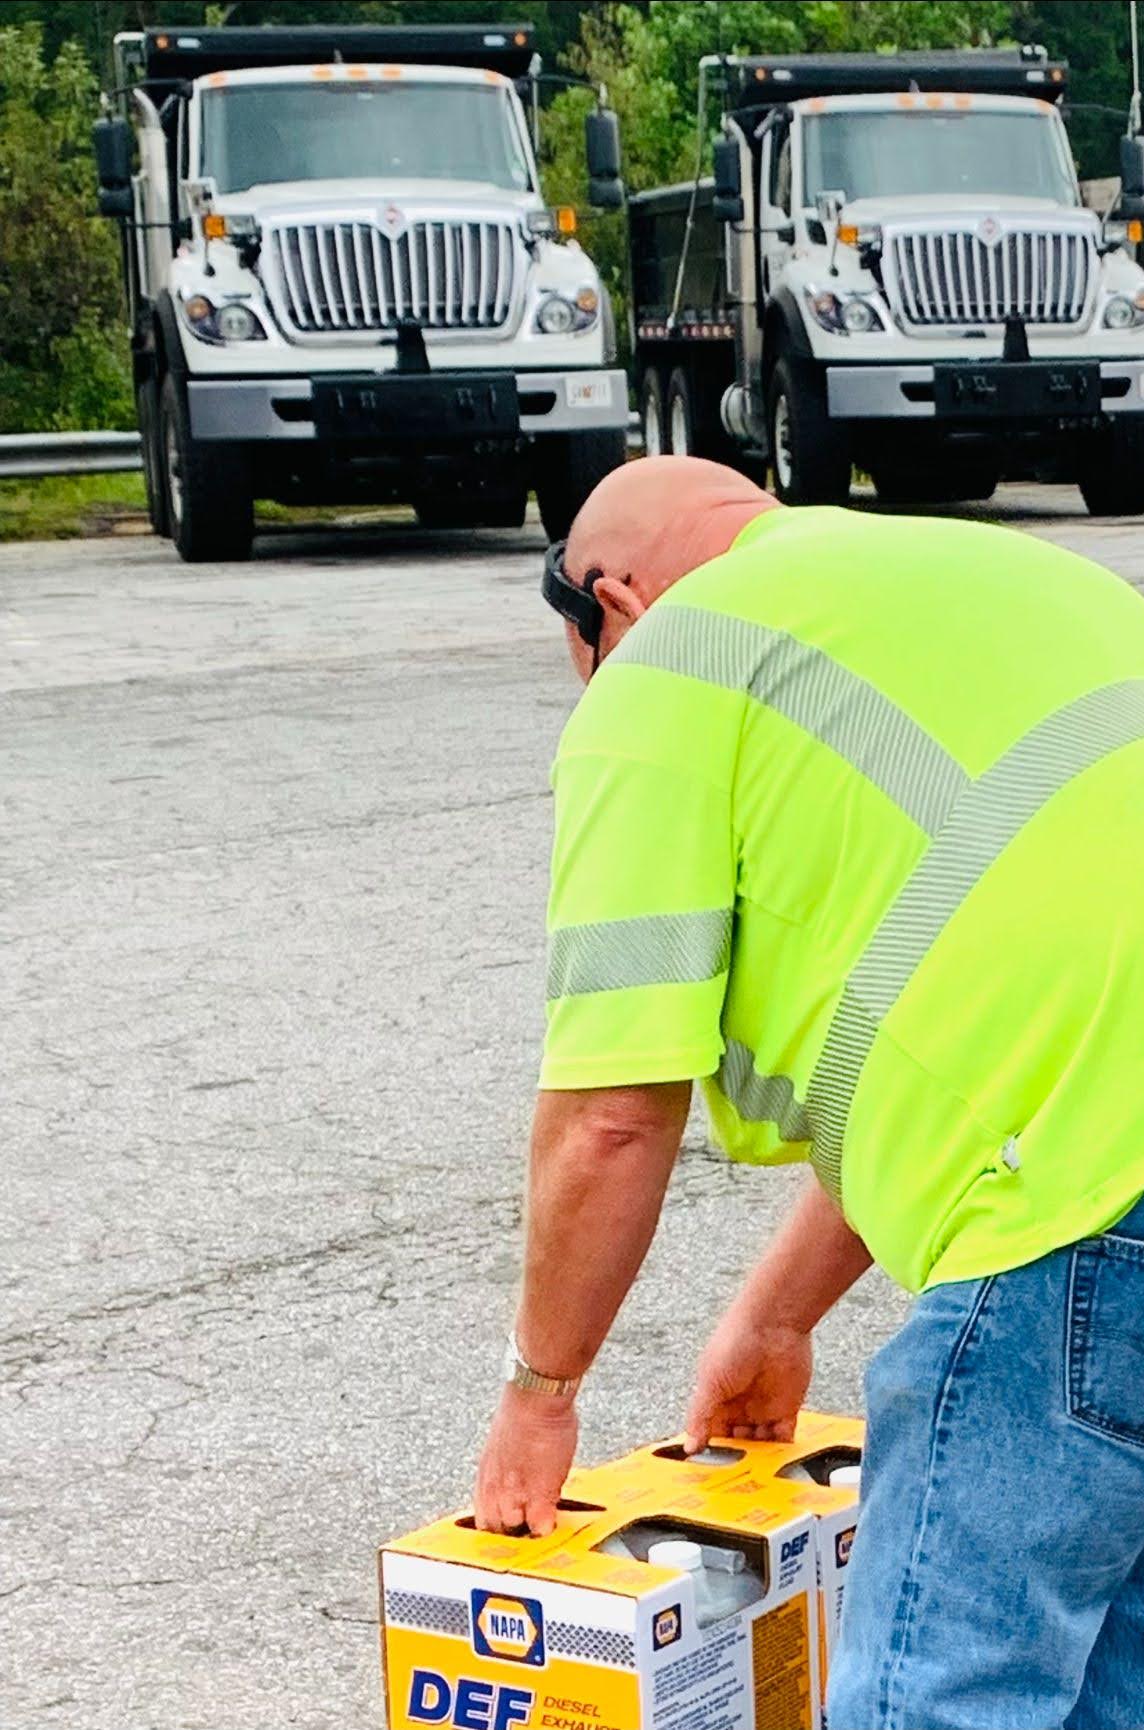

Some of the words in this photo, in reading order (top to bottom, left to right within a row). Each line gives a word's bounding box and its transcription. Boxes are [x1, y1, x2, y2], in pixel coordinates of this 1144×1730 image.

[781, 1530, 810, 1563] DEF
[491, 1614, 526, 1642] NAPA
[407, 1669, 532, 1730] DEF
[543, 1695, 601, 1718] DIESEL
